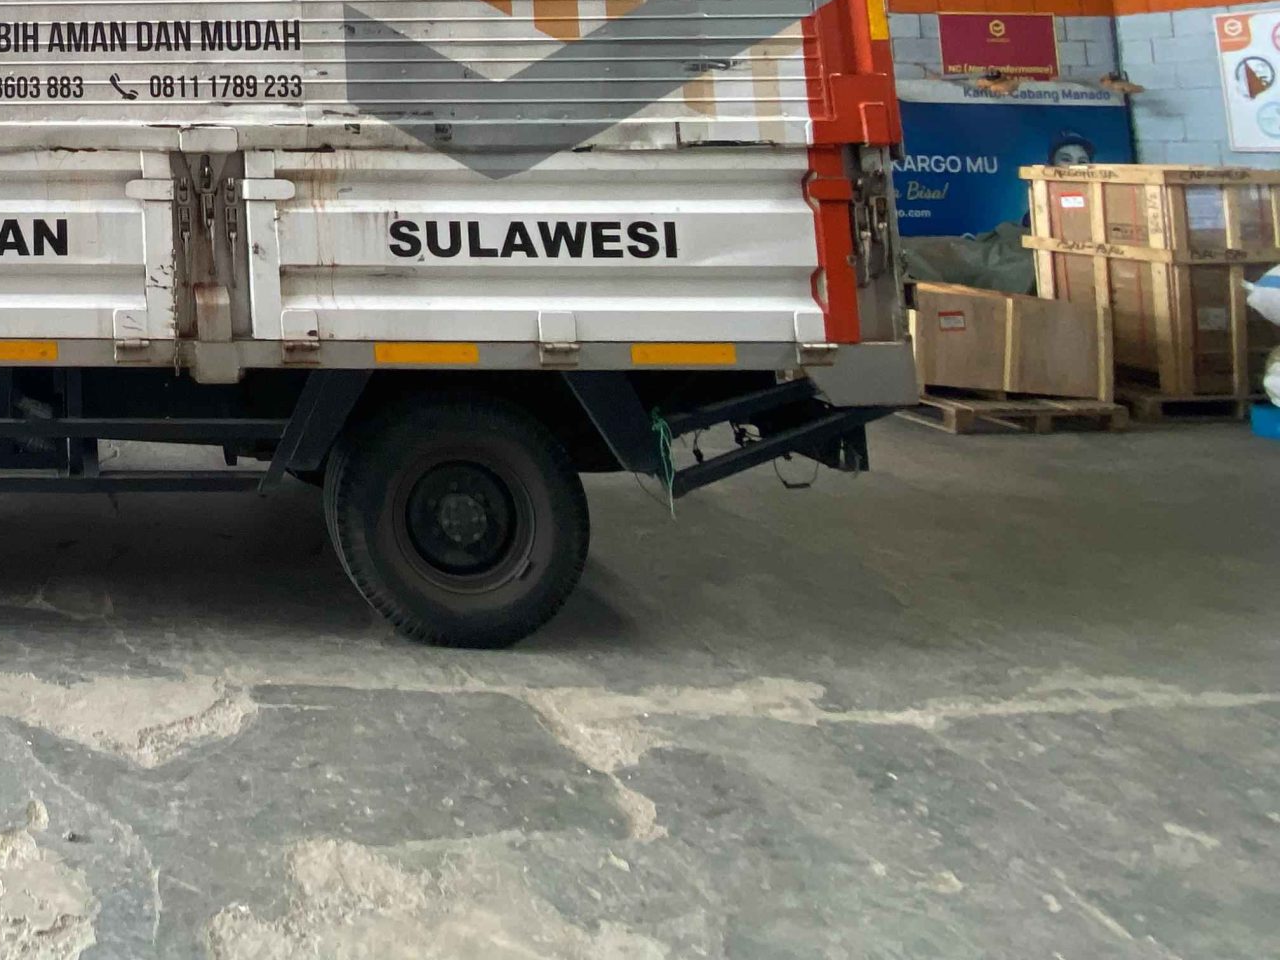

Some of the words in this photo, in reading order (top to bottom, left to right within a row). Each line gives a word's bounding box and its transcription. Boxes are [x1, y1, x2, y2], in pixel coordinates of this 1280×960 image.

[47, 21, 128, 53] AMAN
[136, 20, 192, 52] DAN
[200, 19, 301, 52] MUDAH
[47, 76, 84, 98] 883
[149, 75, 199, 98] 0811
[208, 75, 258, 98] 1789
[264, 75, 303, 98] 233
[1061, 89, 1111, 101] Manado
[966, 156, 998, 174] MU
[906, 181, 949, 200] Bisa!
[389, 220, 678, 258] SULAWESI
